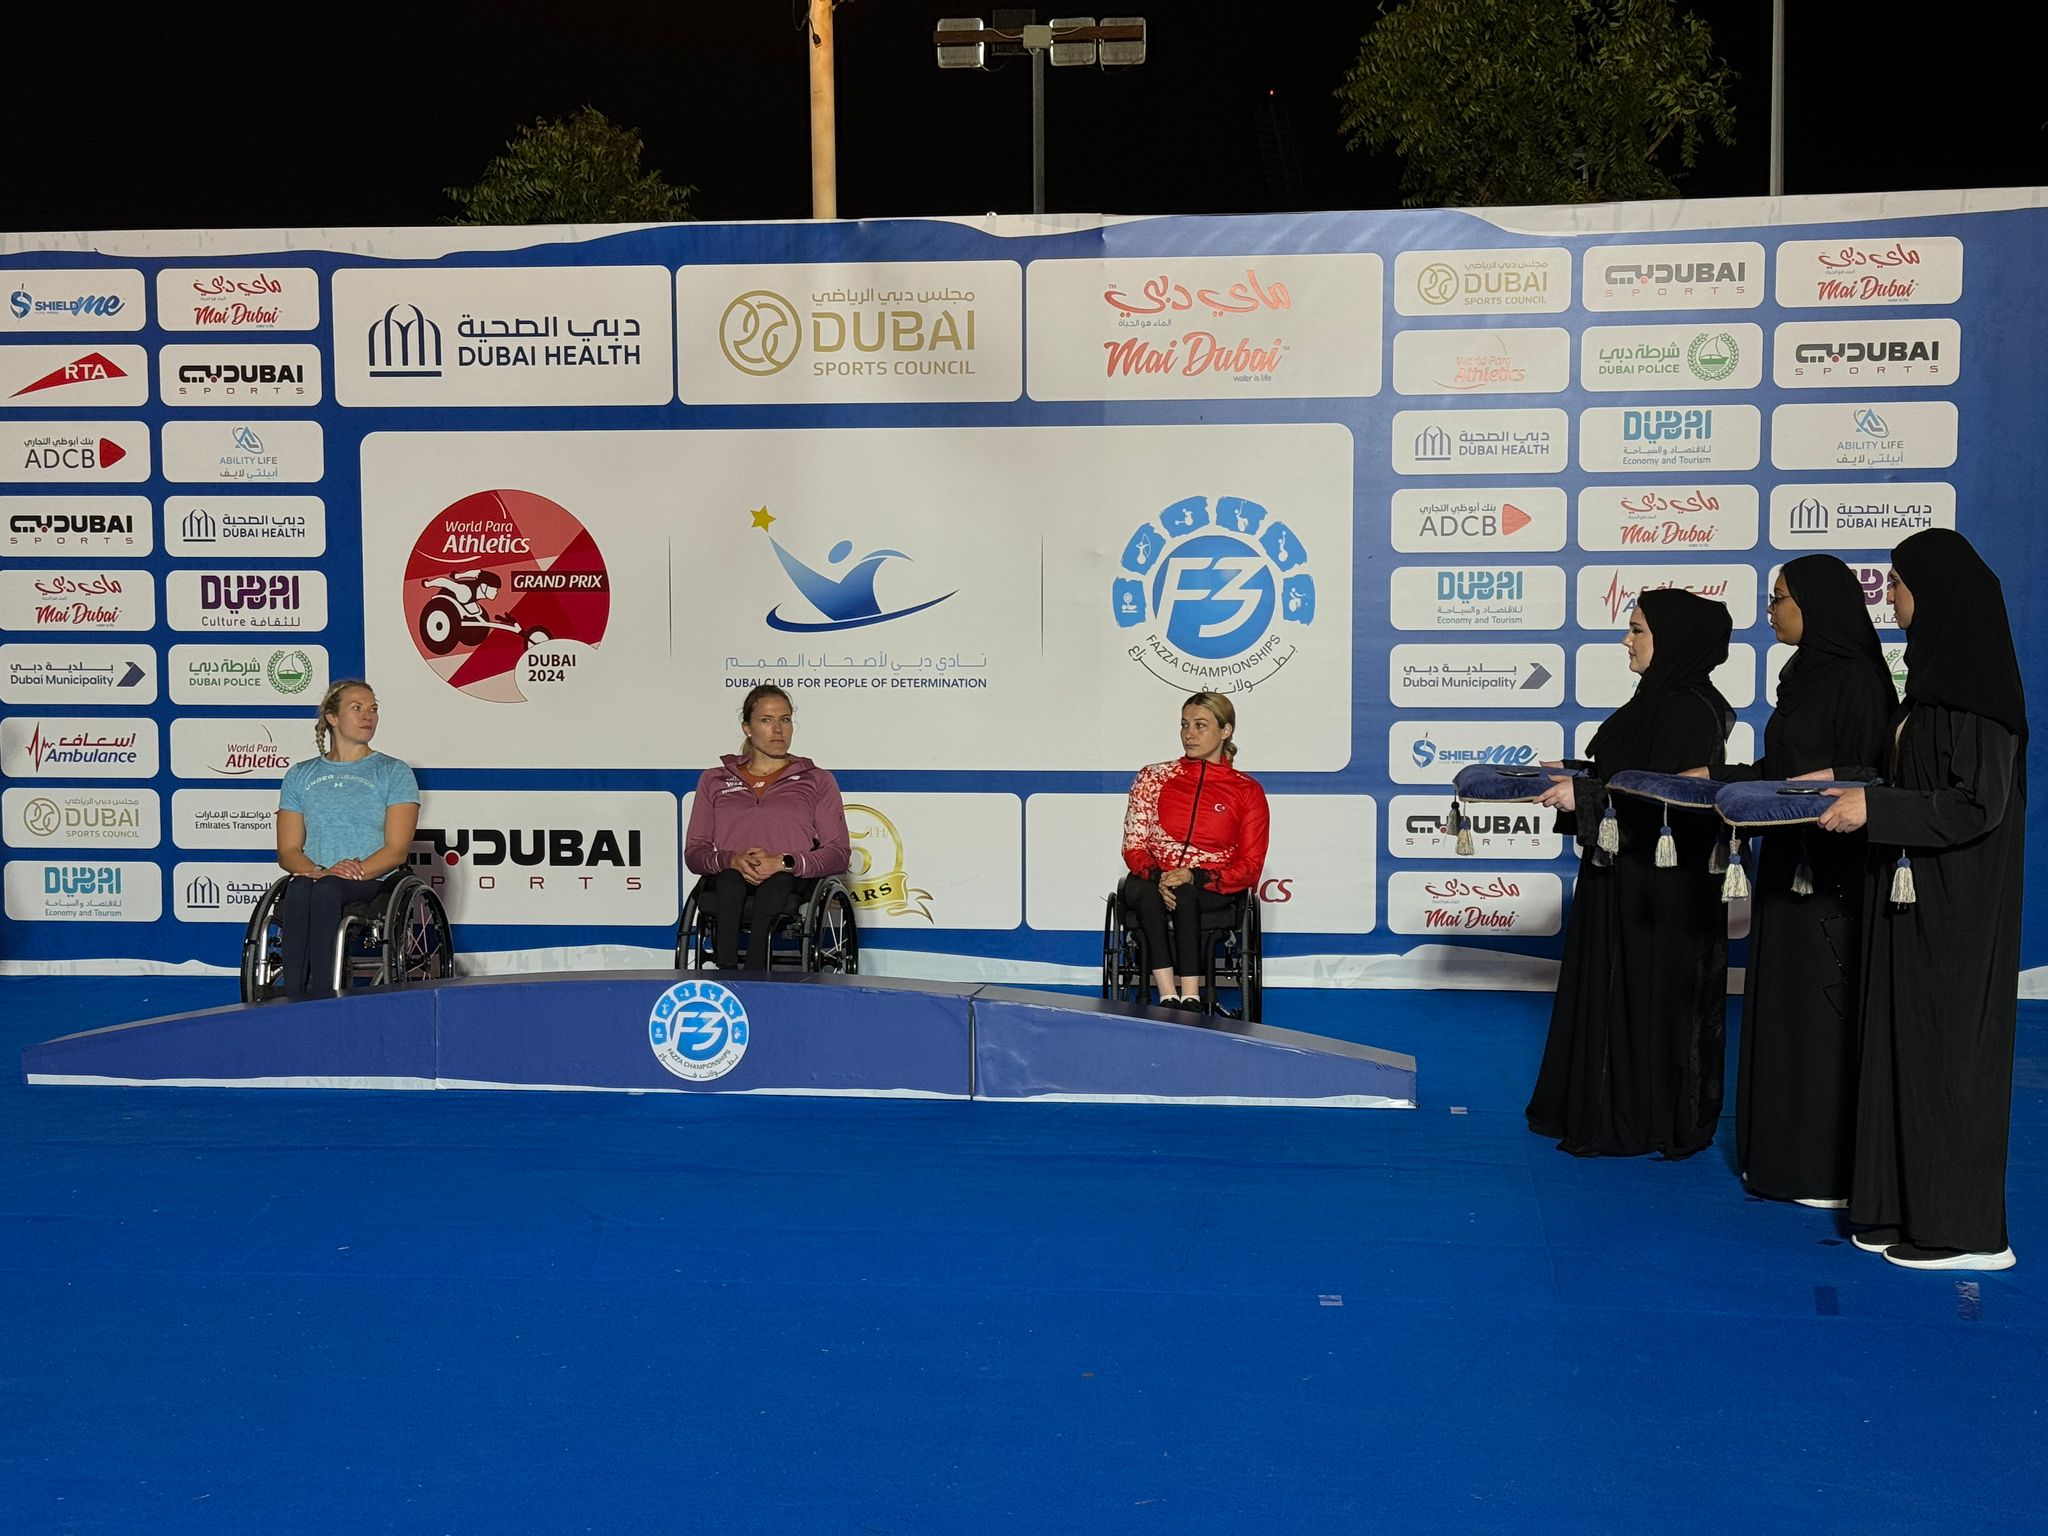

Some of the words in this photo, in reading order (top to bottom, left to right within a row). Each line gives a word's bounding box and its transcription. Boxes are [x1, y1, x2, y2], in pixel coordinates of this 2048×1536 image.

[1465, 272, 1547, 294] DUBAI
[1818, 280, 1858, 300] Mai
[1860, 276, 1915, 300] Dubai
[812, 289, 874, 306] الرياضي
[878, 291, 914, 305] دبي
[918, 288, 975, 304] مجلس
[1604, 286, 1745, 297] SPORTS
[1464, 297, 1502, 306] SPORTS
[1505, 296, 1547, 305] COUNCIL
[194, 305, 229, 325] Mai
[232, 303, 279, 323] Dubai
[458, 314, 557, 343] الصحية
[568, 319, 640, 342] دبي
[812, 310, 975, 352] DUBAI
[458, 346, 536, 366] DUBAI
[545, 345, 640, 365] HEALTH
[1104, 338, 1178, 378] Mai
[1182, 332, 1285, 376] Dubai
[1600, 346, 1632, 363] دبي
[1635, 341, 1680, 361] شرطة
[64, 364, 110, 380] RTA
[813, 361, 887, 376] SPORTS
[894, 360, 976, 376] COUNCIL
[1600, 366, 1634, 375] DUBAI
[1638, 364, 1680, 374] POLICE
[1795, 366, 1939, 376] SPORTS
[1623, 410, 1712, 442] DUBAI
[1459, 430, 1509, 444] الصحية
[1514, 432, 1549, 443] دبي
[1459, 445, 1497, 456] DUBAI
[1502, 444, 1549, 455] HEALTH
[1837, 441, 1878, 450] ABILITY
[1881, 440, 1904, 449] LIFE
[24, 450, 95, 469] ADCB
[220, 457, 256, 465] ABILITY
[258, 457, 278, 465] LIFE
[1623, 456, 1659, 466] Economy
[1662, 456, 1676, 464] and
[1680, 456, 1711, 464] Tourism
[1836, 503, 1889, 517] الصحية
[1894, 505, 1932, 516] دبي
[222, 514, 267, 528] الصحية
[271, 516, 305, 527] دبي
[446, 521, 482, 533] World
[485, 522, 513, 533] Para
[1420, 516, 1497, 536] ADCB
[1837, 518, 1877, 529] DUBAI
[1882, 518, 1931, 528] HEALTH
[222, 528, 258, 538] DUBAI
[262, 528, 305, 538] HEALTH
[1620, 524, 1659, 544] Mai
[1662, 522, 1715, 545] Dubai
[442, 534, 530, 554] Athletics
[514, 575, 566, 589] GRAND
[569, 575, 602, 589] PRIX
[1438, 572, 1523, 603] DUBAI
[200, 576, 300, 614] DUBAI
[35, 604, 70, 624] Mai
[72, 603, 119, 623] Dubai
[1438, 617, 1472, 625] Economy
[1475, 616, 1489, 624] and
[1492, 616, 1523, 624] Tourism
[201, 616, 245, 627] Culture
[250, 617, 300, 627] للثقافة
[528, 654, 576, 667] DUBAI
[1146, 634, 1180, 668] FAZZA
[1182, 634, 1281, 678] CHAMPIONSHIPS
[10, 663, 42, 674] دبي
[189, 662, 218, 676] دبي
[223, 658, 261, 674] شرطة
[1404, 664, 1438, 675] دبي
[10, 675, 43, 685] Dubai
[46, 675, 114, 687] Municipality
[189, 678, 222, 687] DUBAI
[224, 678, 261, 687] POLICE
[528, 670, 565, 682] 2024
[798, 678, 820, 688] FOR
[824, 678, 867, 688] PEOPLE
[871, 678, 887, 688] OF
[891, 678, 987, 688] DETERMINATION
[1404, 677, 1439, 688] Dubai
[1442, 677, 1516, 690] Municipality
[45, 748, 136, 763] Ambulance
[228, 744, 255, 753] World
[256, 744, 277, 753] Para
[226, 754, 289, 769] Athletics
[66, 808, 139, 827] DUBAI
[233, 822, 272, 831] Transport
[66, 830, 100, 838] SPORTS
[102, 830, 139, 838] COUNCIL
[473, 830, 641, 867] DUBAI
[1406, 838, 1540, 846] SPRTS
[44, 867, 121, 897] DUBAI
[431, 877, 642, 890] PORTS
[226, 895, 258, 904] DUBA
[45, 910, 76, 918] Economy
[1424, 910, 1462, 928] Mai
[1465, 907, 1516, 928] Dubai
